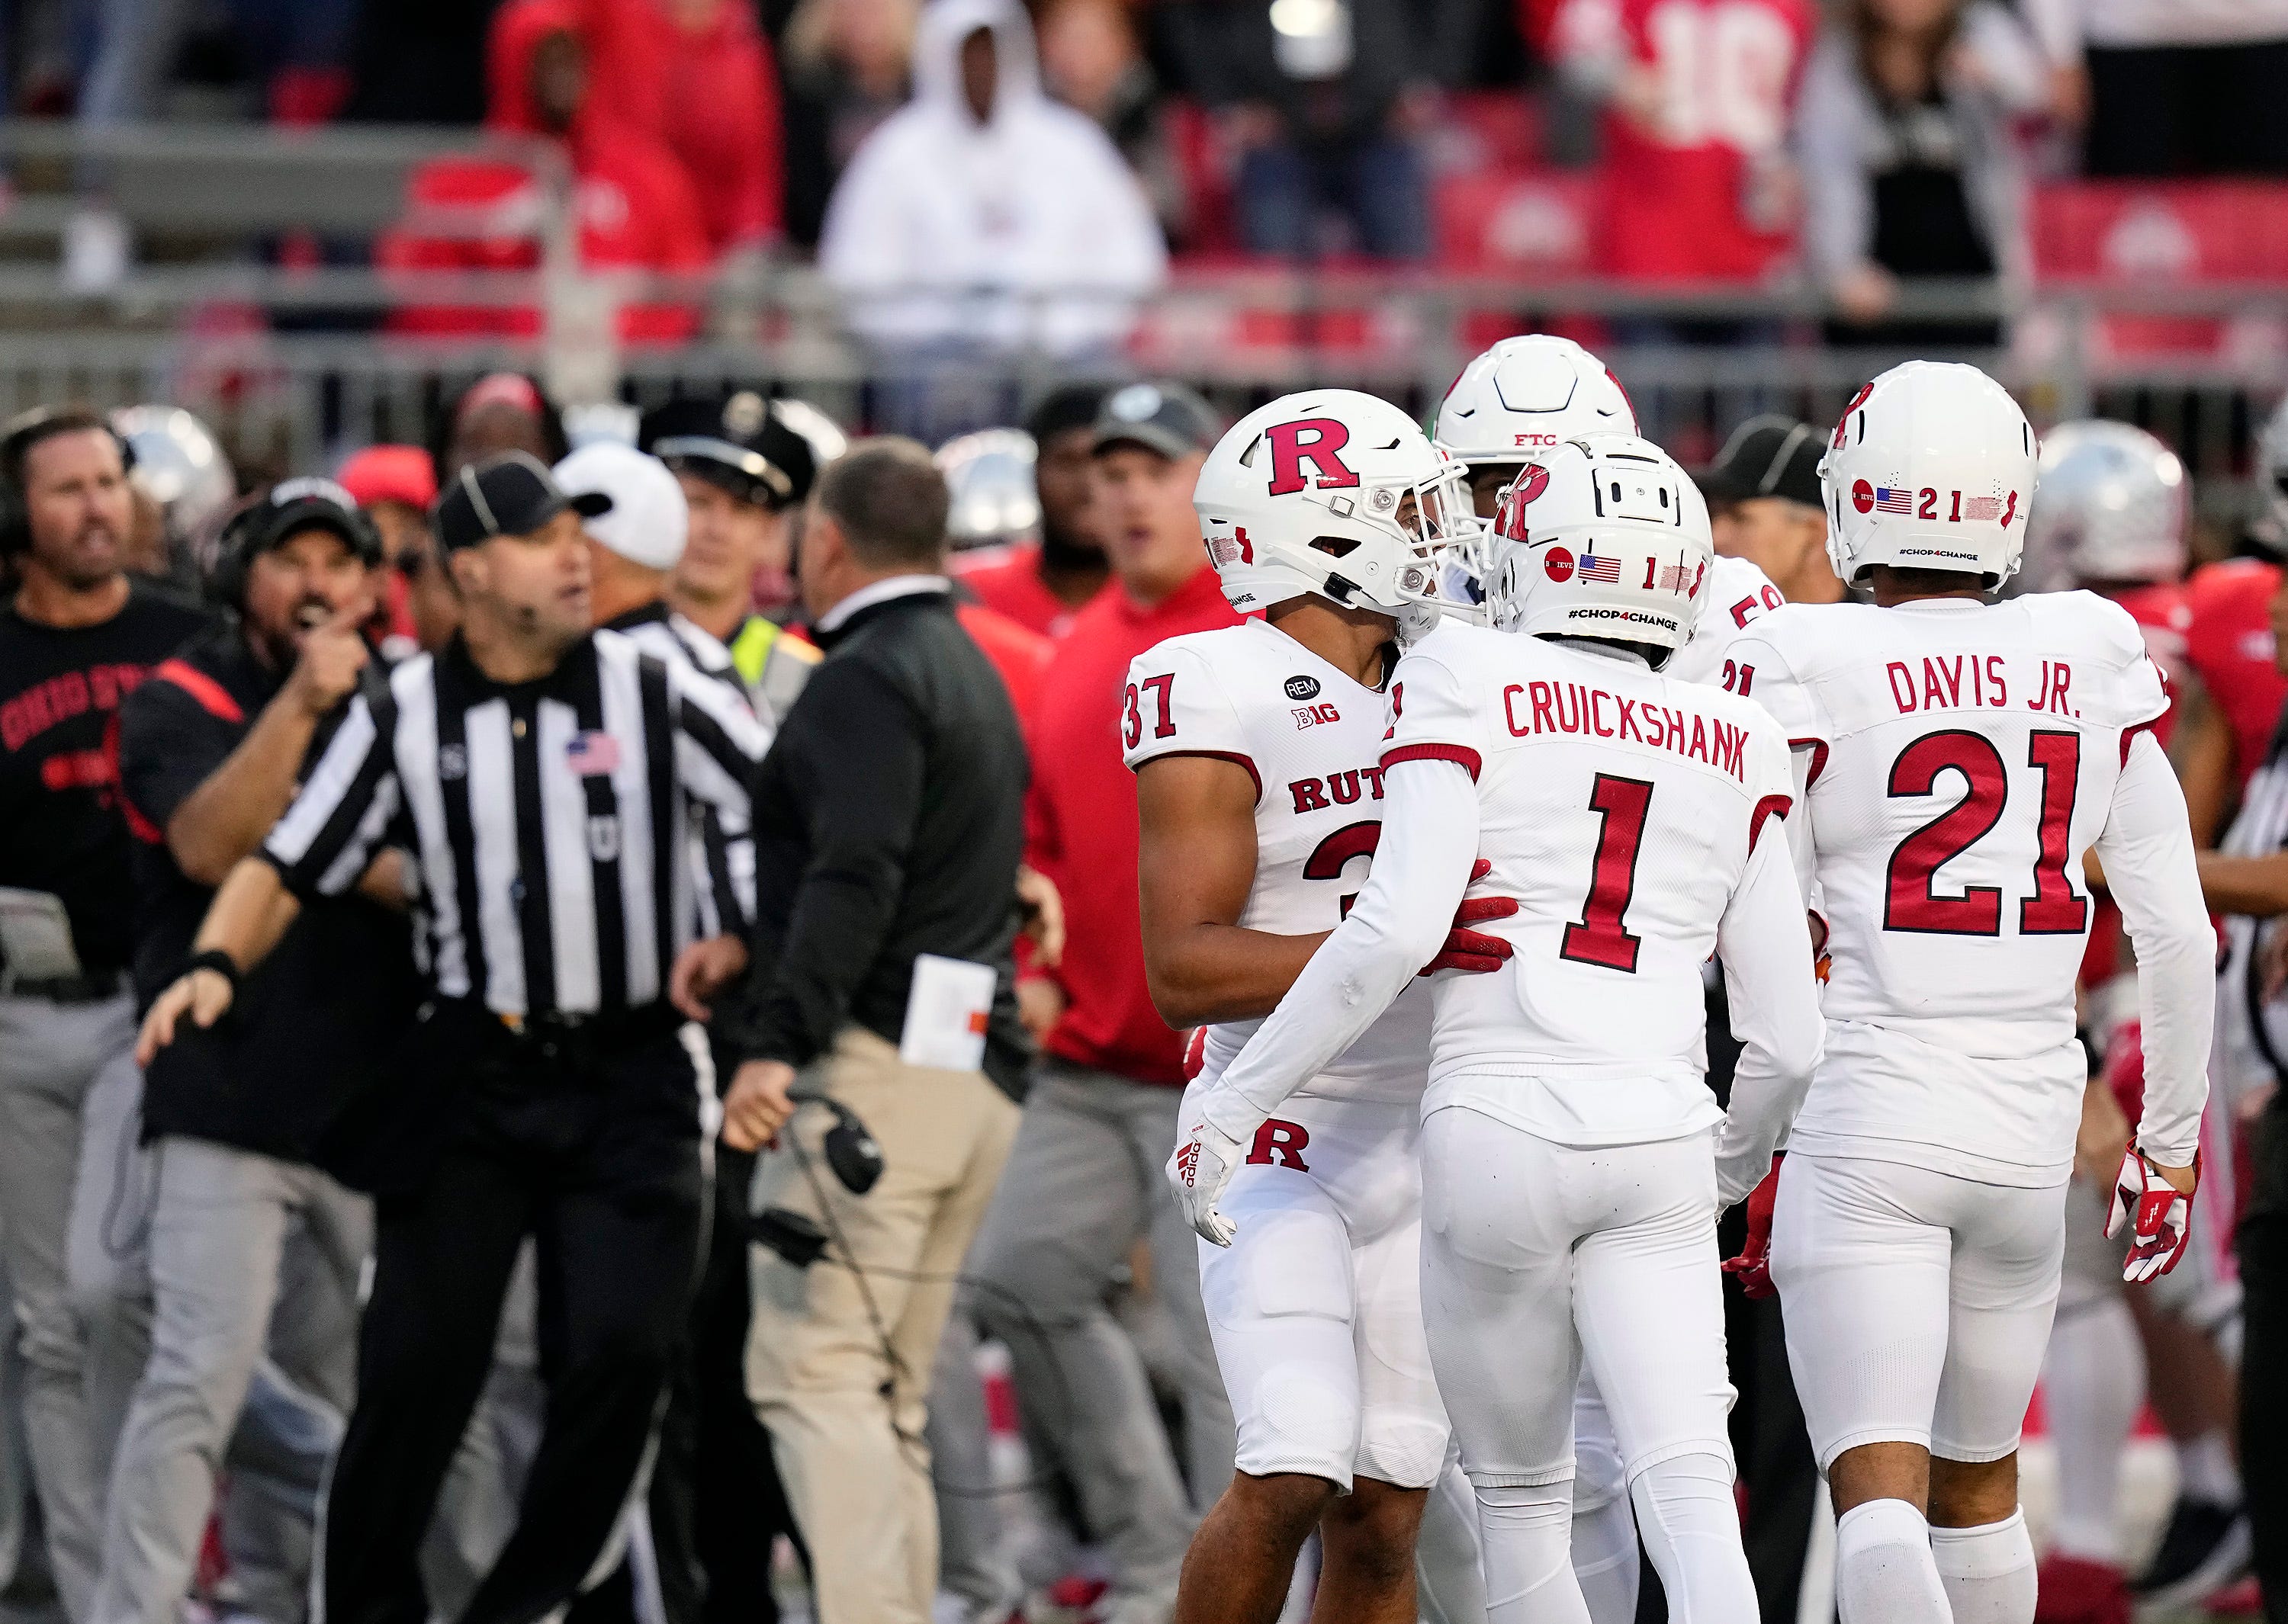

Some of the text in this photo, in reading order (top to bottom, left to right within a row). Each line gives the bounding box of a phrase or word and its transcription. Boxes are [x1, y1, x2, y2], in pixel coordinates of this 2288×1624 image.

[1265, 418, 1360, 497] R
[1514, 434, 1557, 446] FTC
[1918, 487, 1962, 522] 21
[1642, 557, 1656, 590] 1
[1899, 548, 1978, 561] #CHOP4CHANGE
[1568, 609, 1678, 632] #CHOP4CHANGE
[1123, 672, 1177, 750] 37
[1285, 678, 1319, 698] REM
[1886, 654, 2081, 719] DAVIS JR.
[1503, 681, 1750, 784] CRUICKSHANK
[1882, 728, 2087, 936] 21
[1560, 772, 1655, 974] 1
[1245, 1117, 1310, 1173] R
